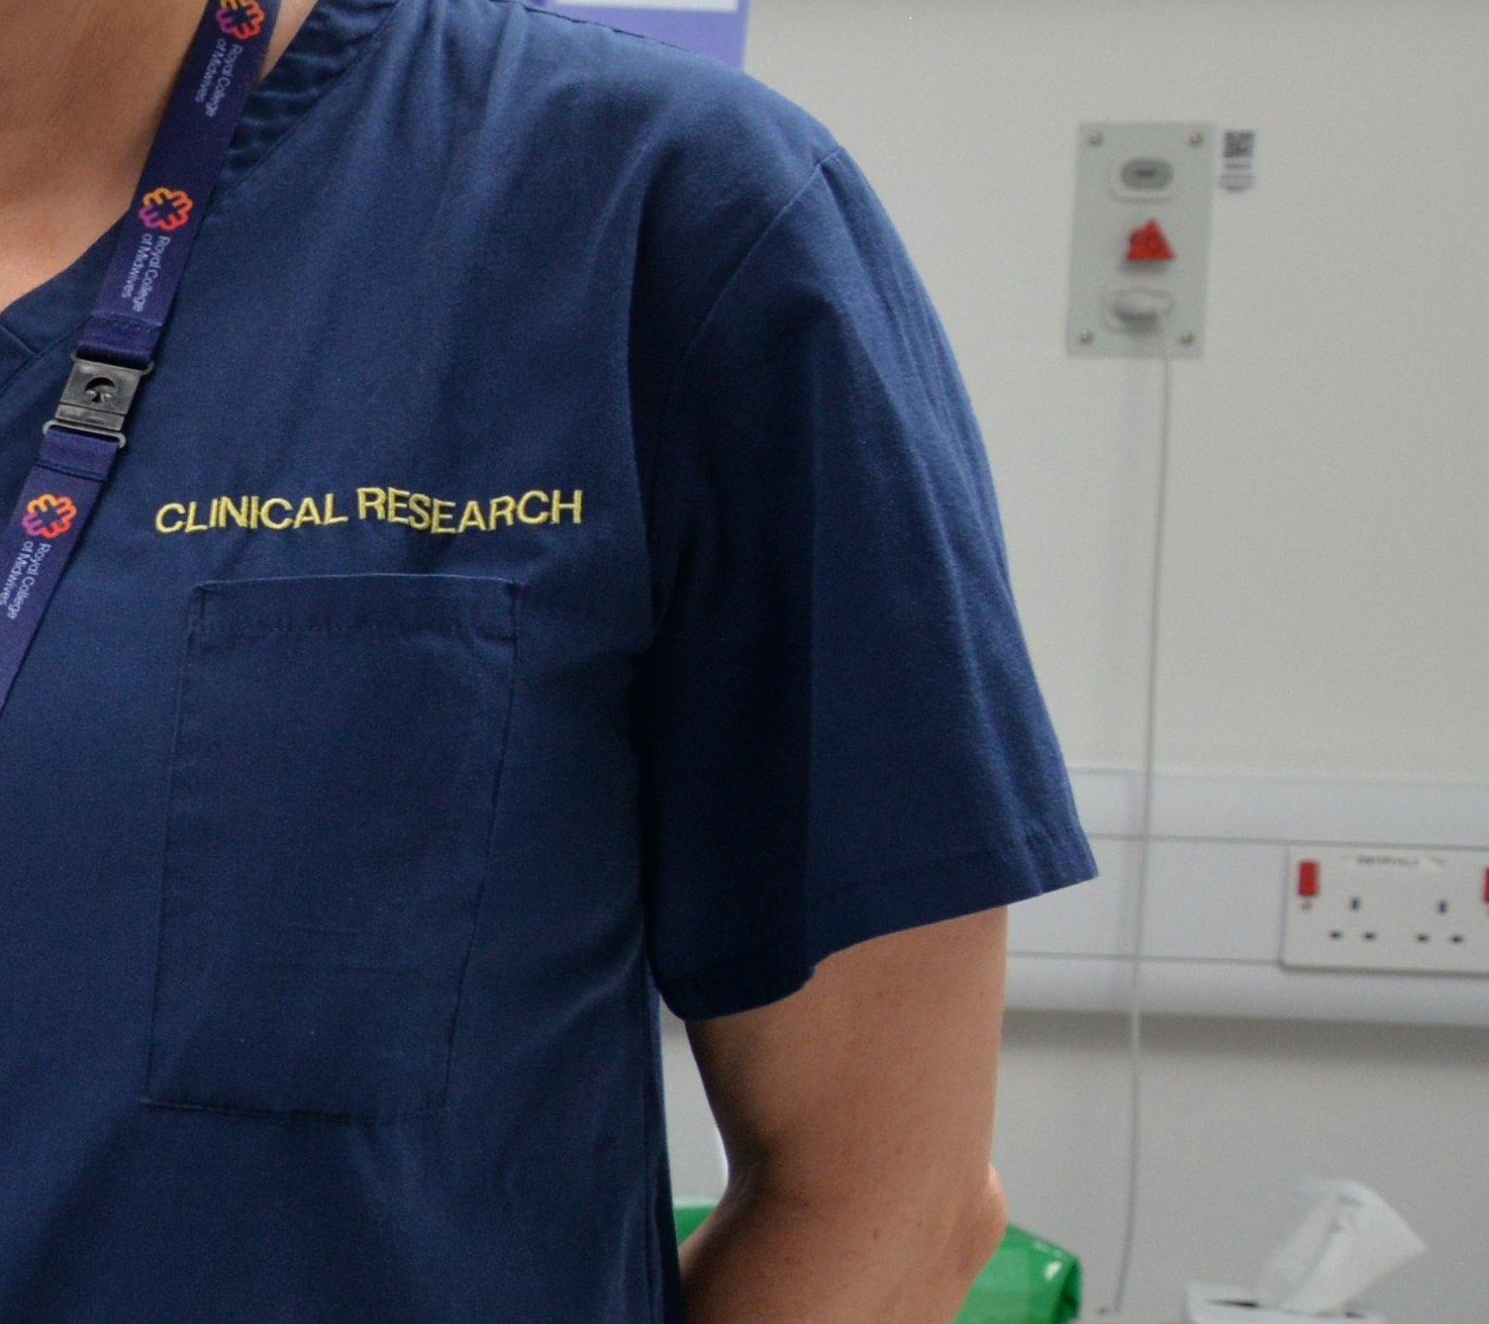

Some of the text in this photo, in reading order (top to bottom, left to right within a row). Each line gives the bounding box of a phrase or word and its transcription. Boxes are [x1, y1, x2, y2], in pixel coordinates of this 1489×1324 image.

[121, 234, 153, 299] of Midwives
[133, 236, 171, 312] Royal College
[154, 486, 583, 534] CLINICAL RESEARCH
[21, 541, 33, 552] of
[7, 542, 52, 620] Royal College
